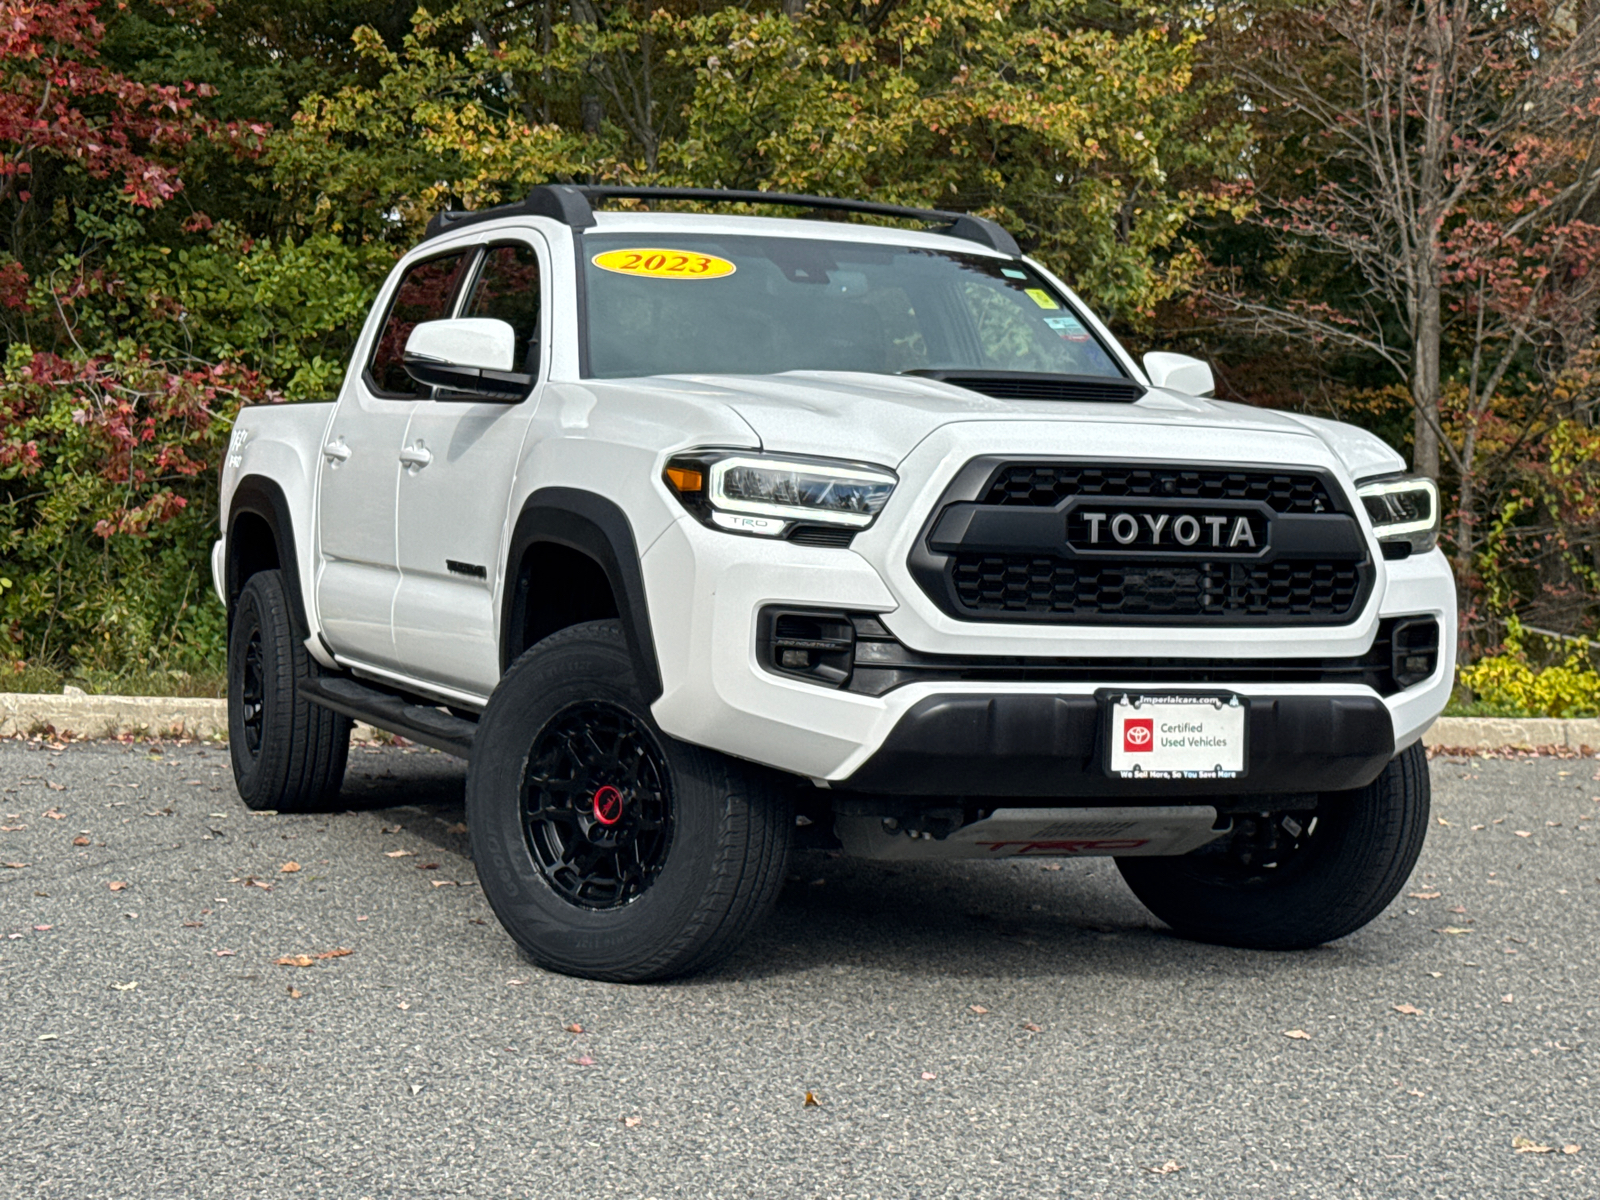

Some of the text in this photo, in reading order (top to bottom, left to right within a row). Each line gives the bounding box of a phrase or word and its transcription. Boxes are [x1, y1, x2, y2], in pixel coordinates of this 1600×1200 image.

[619, 254, 712, 273] 2023
[730, 516, 768, 528] TRD
[1081, 513, 1256, 547] TOYOTA
[1161, 722, 1203, 733] Certified
[1161, 736, 1227, 747] Used Vehicles
[1134, 770, 1148, 778] Sell
[975, 840, 1150, 853] TRD
